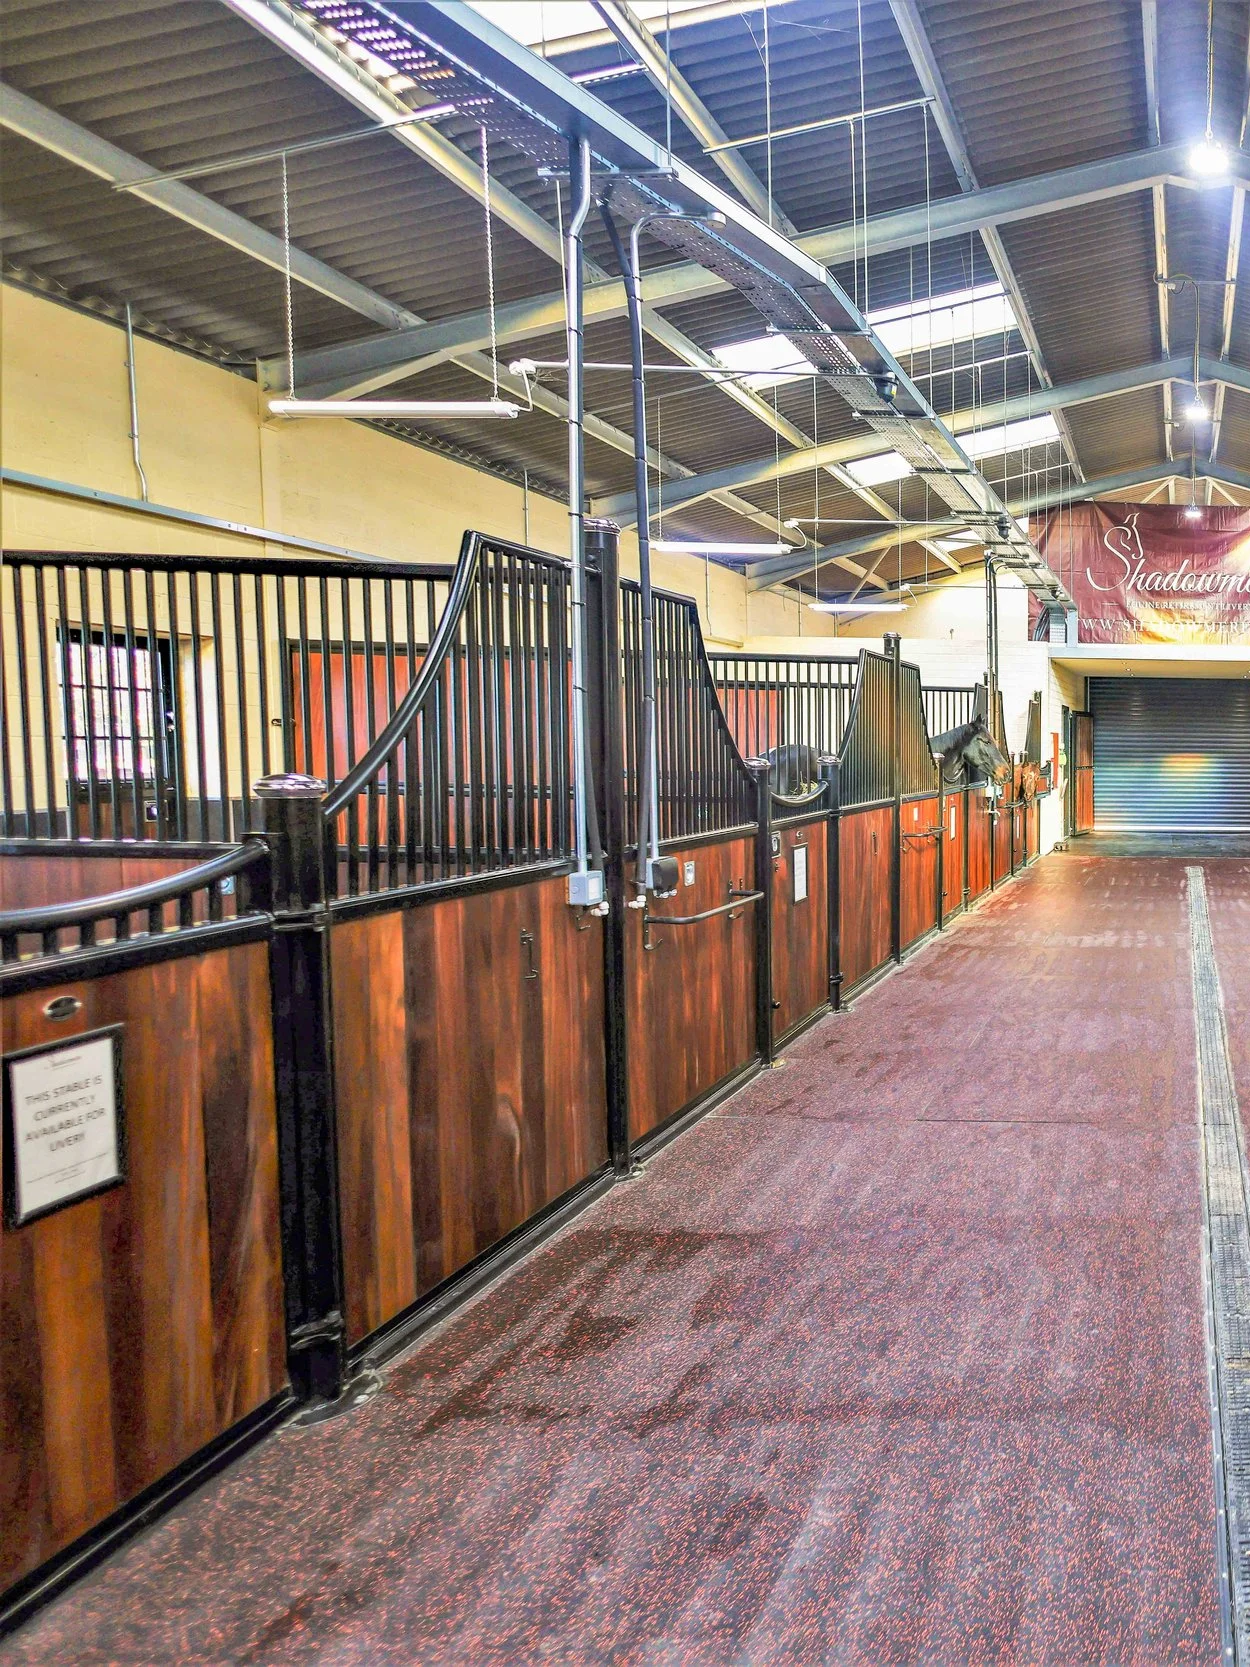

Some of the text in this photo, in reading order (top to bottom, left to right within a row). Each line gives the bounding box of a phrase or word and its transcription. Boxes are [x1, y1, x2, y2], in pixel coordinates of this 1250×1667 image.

[25, 1074, 103, 1105] THIS STABLE IS
[33, 1095, 96, 1121] CURRENTLY
[25, 1107, 106, 1142] AVAILABLE FOR
